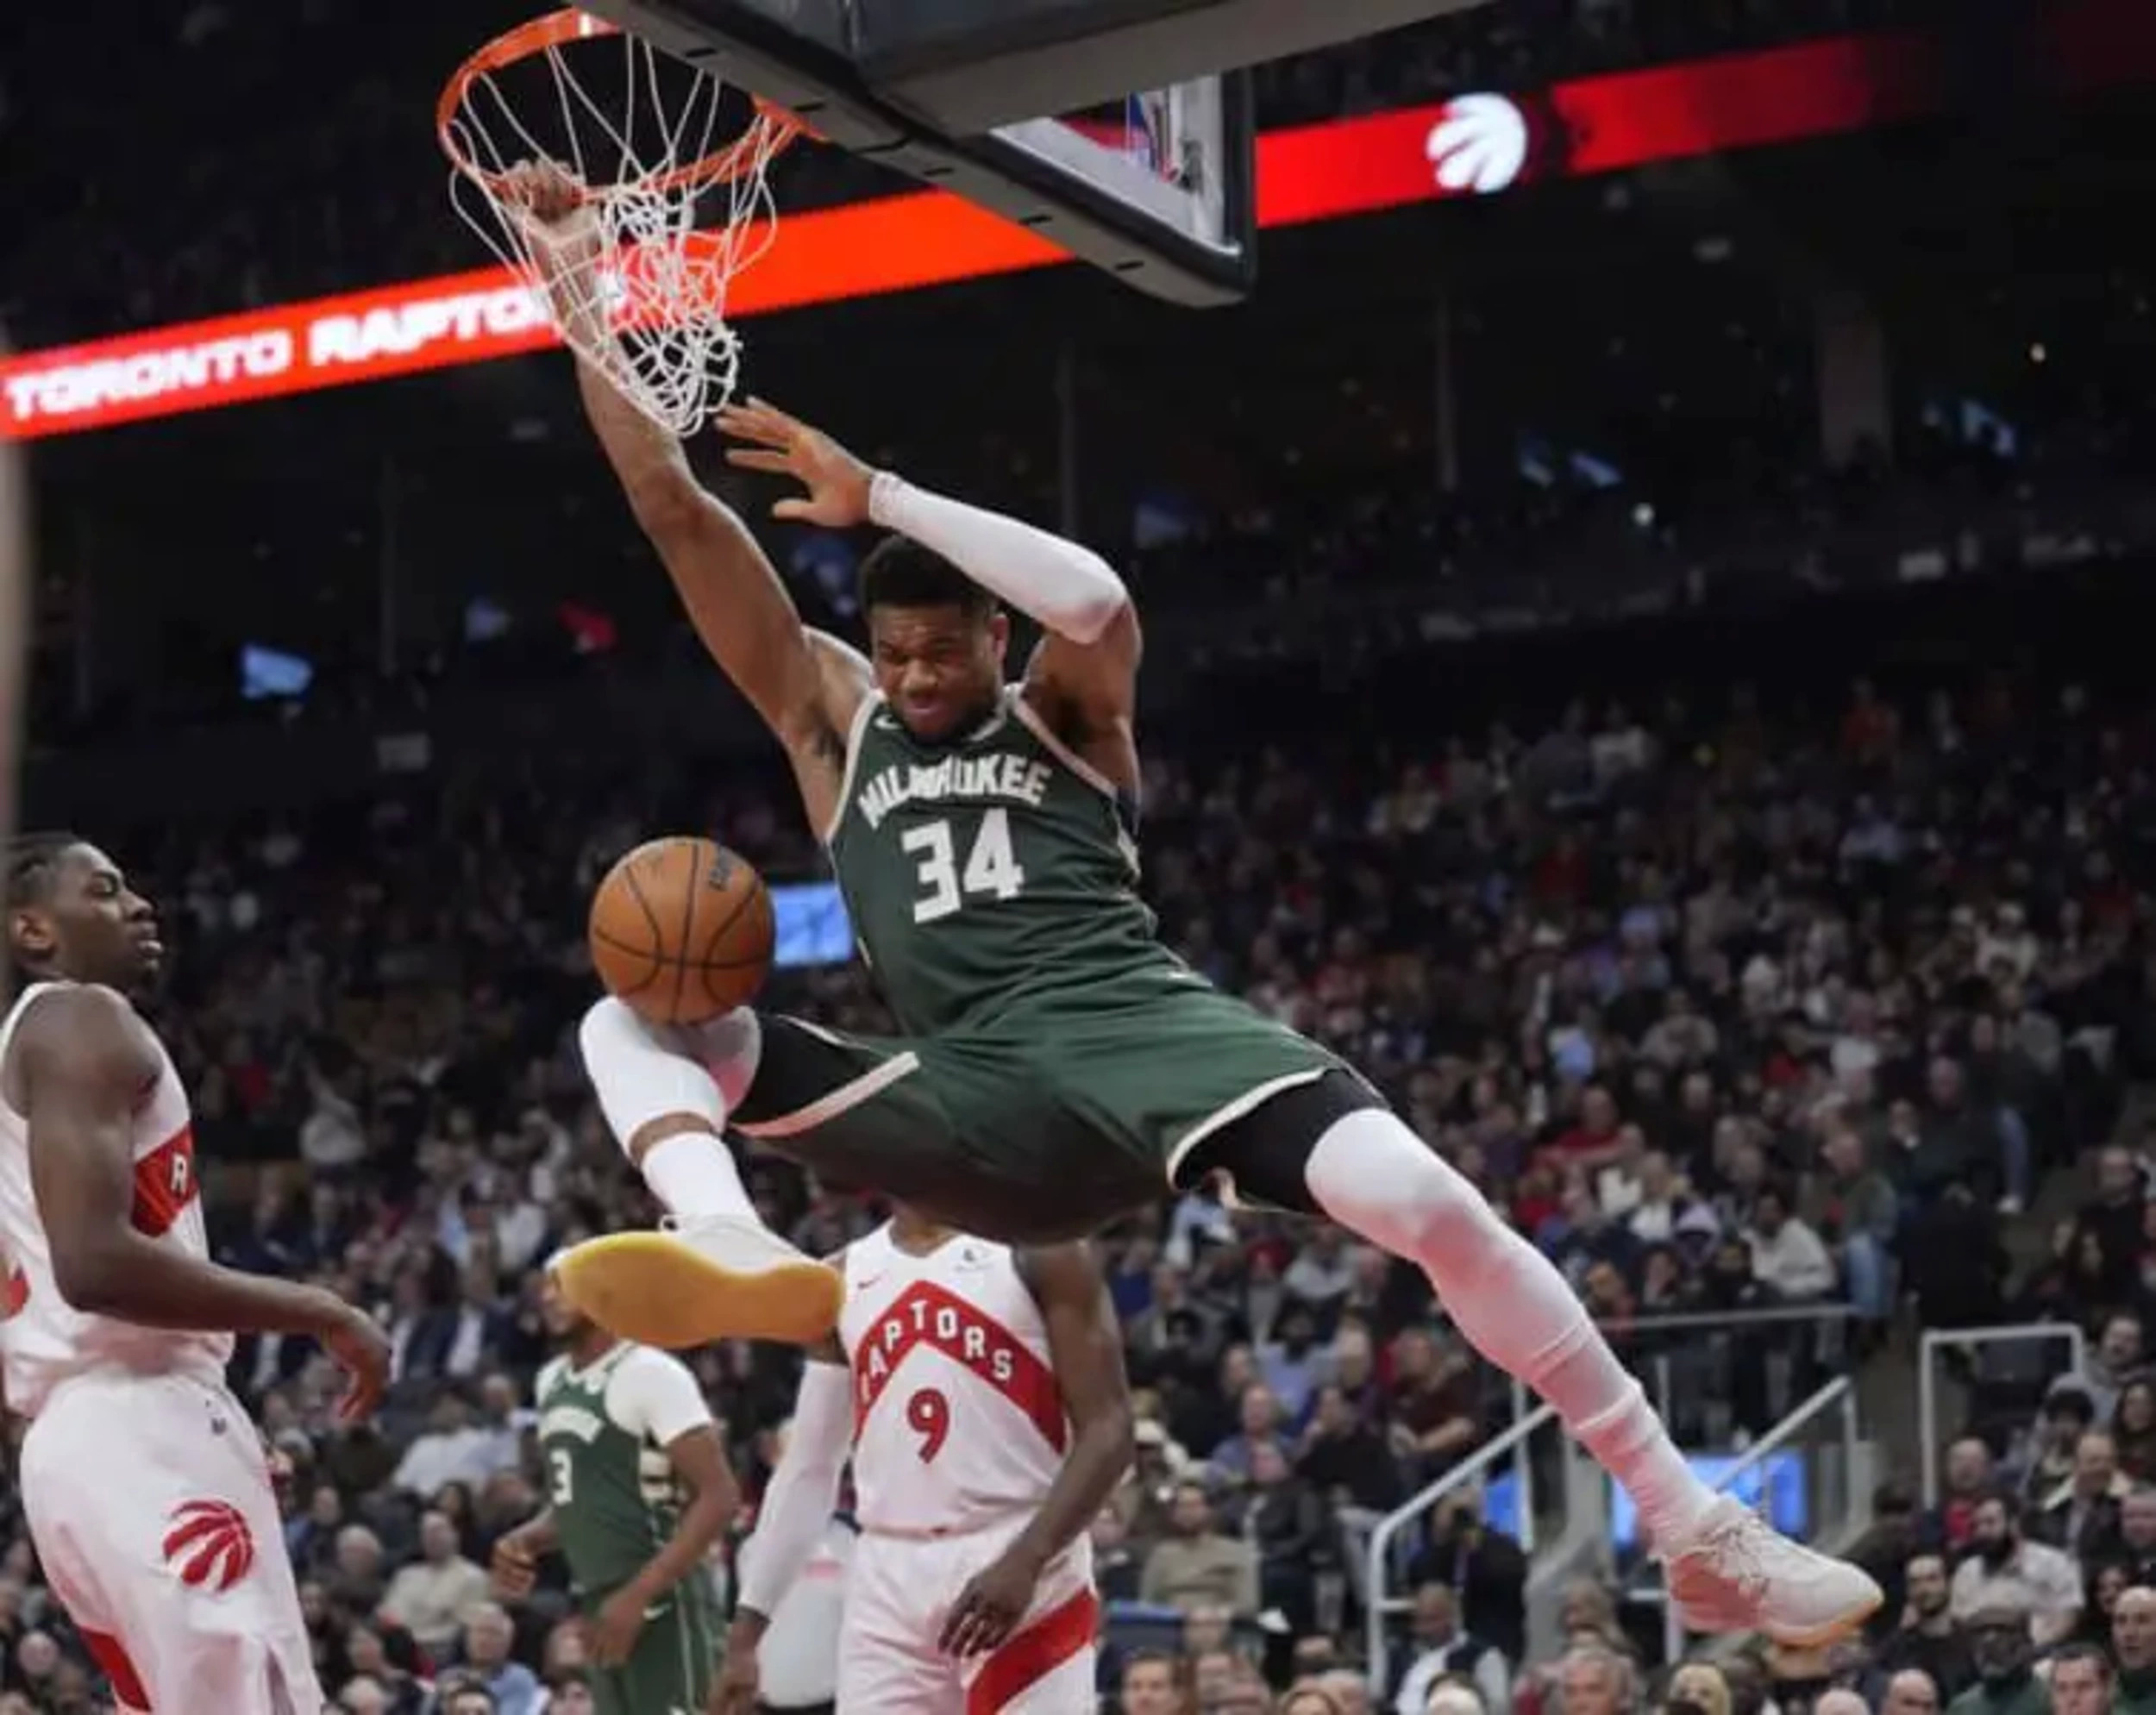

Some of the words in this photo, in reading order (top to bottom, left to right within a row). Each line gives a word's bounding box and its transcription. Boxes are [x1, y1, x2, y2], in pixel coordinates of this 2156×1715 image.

[5, 329, 291, 421] TORONTO
[309, 269, 630, 366] RAPTO
[857, 754, 1052, 830] MILWAUKEE
[901, 807, 1025, 923] 34
[907, 1387, 950, 1464] 9
